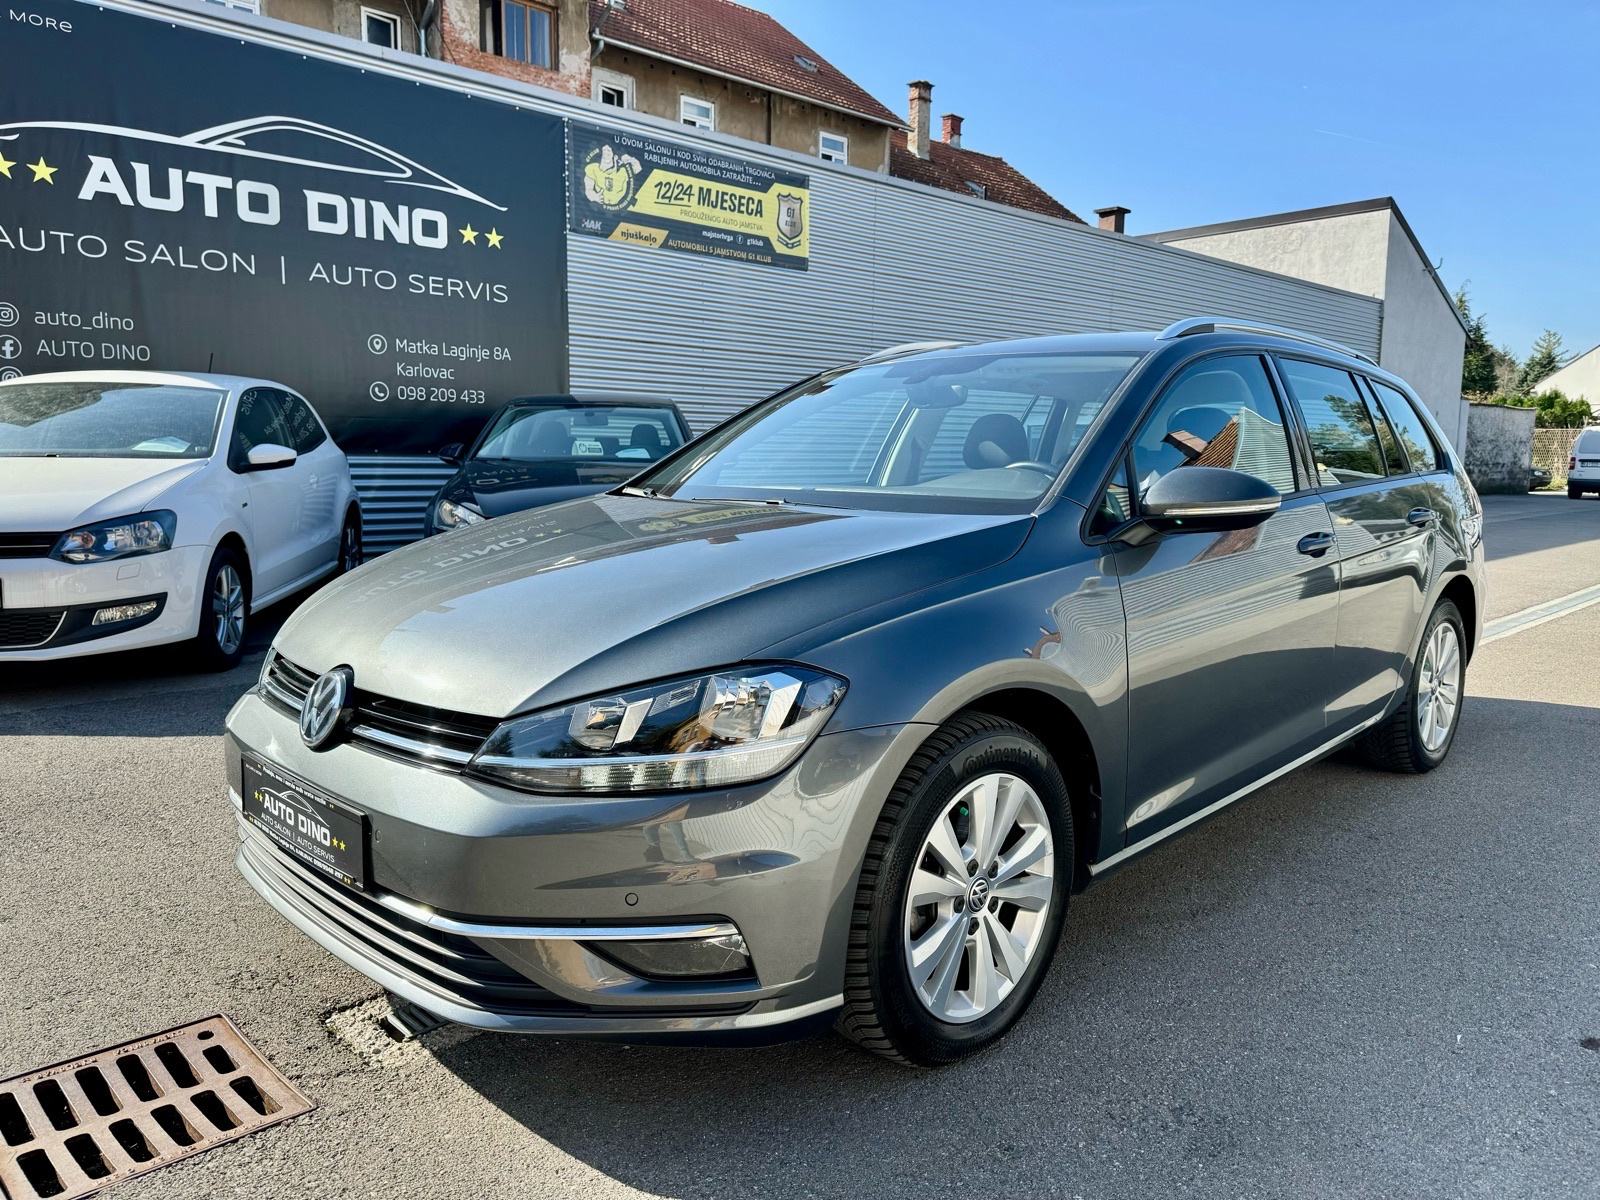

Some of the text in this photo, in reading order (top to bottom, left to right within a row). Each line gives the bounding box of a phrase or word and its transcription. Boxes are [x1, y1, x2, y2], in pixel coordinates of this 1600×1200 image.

[614, 135, 620, 143] U
[621, 137, 643, 149] OVOM
[644, 142, 672, 156] SALONU
[677, 151, 691, 160] KOD
[692, 154, 707, 164] SVIH
[708, 158, 744, 172] ODABRANIH
[745, 166, 776, 180] TRGOVACA
[644, 152, 678, 167] RABLJENIH
[680, 162, 721, 177] AUTOMOBILA
[78, 154, 448, 249] AUTO DINO
[654, 179, 695, 203] 12/24
[697, 186, 763, 218] MJESECA
[680, 208, 763, 231] PRODUŽENOG AUTO JAMSTVA
[621, 229, 657, 243] njuškalo
[668, 239, 708, 253] AUTOMOBILI
[713, 246, 746, 260] JAMSTVOM
[756, 254, 772, 263] KLUB
[0, 225, 107, 258] AUTO
[124, 240, 256, 275] SALON
[309, 262, 397, 290] AUTO
[408, 274, 509, 303] SERVIS
[34, 311, 134, 331] auto_dino
[37, 339, 151, 361] AUTO DINO
[395, 338, 512, 362] Matka Laginje 8A
[396, 362, 455, 379] Karlovac
[397, 386, 486, 404] 098 209 433
[264, 793, 294, 826] AUTO
[298, 813, 330, 847] DINO
[261, 812, 273, 826] AUTO
[297, 836, 312, 850] AUTO
[313, 845, 335, 863] SERVIS
